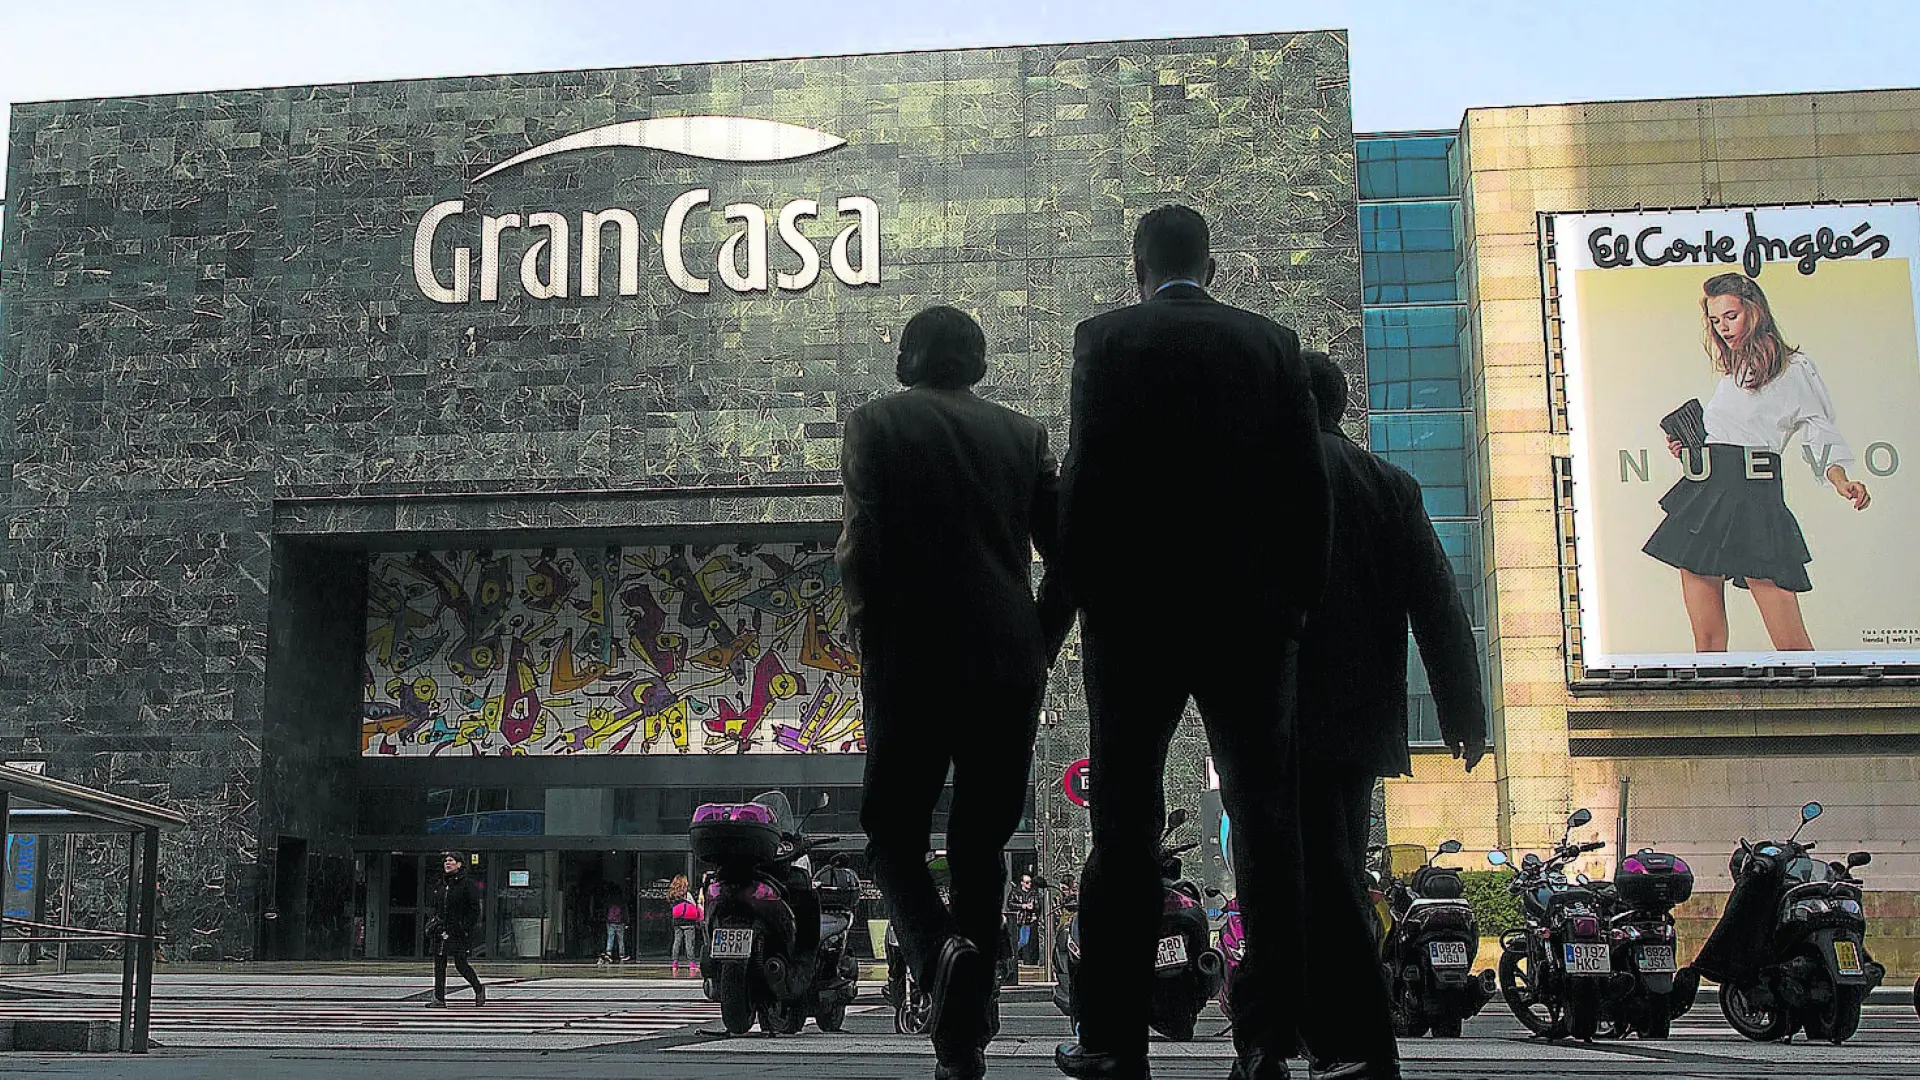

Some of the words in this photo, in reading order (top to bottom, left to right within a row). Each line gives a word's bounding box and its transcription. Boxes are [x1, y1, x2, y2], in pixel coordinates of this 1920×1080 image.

[1588, 226, 1634, 269] El
[1635, 226, 1737, 267] Corte
[1742, 212, 1890, 279] Inglés
[1618, 441, 1900, 482] NUEVO
[720, 942, 743, 953] GYN
[1574, 945, 1606, 958] 9192
[1575, 958, 1601, 971] HKC
[1647, 956, 1667, 967] JSX
